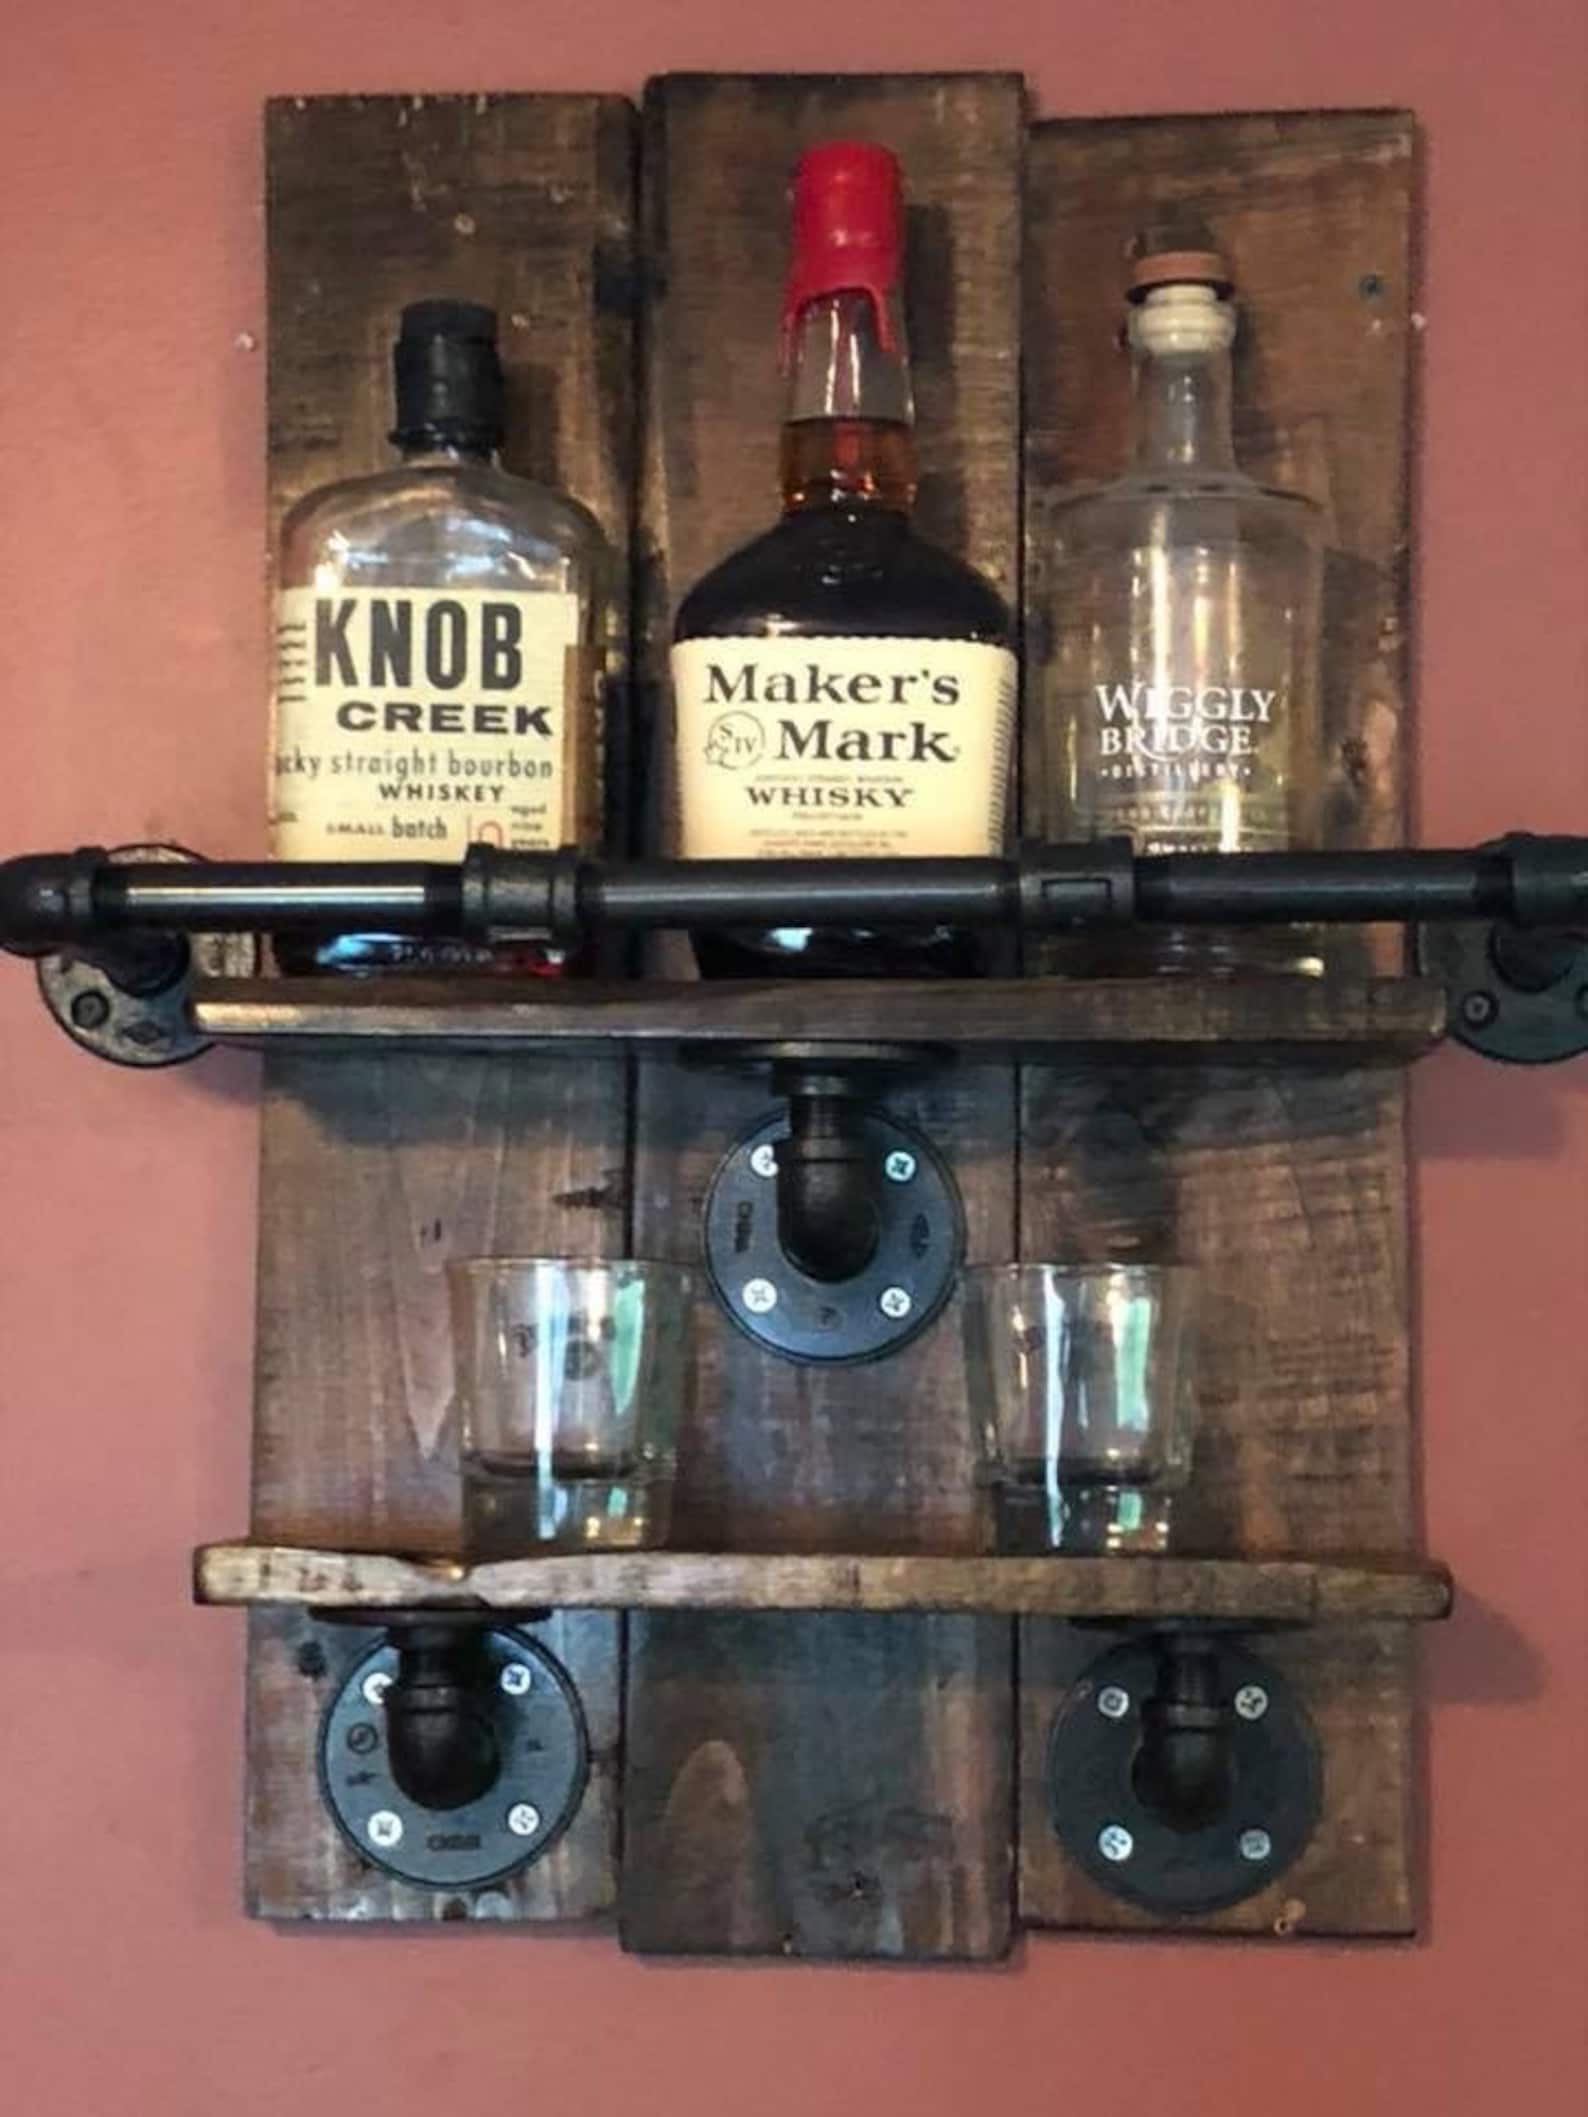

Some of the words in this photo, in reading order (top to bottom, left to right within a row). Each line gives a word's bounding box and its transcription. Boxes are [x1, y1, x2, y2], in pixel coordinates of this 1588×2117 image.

[314, 599, 522, 690] KNOB
[704, 663, 960, 706] Maker's
[1096, 682, 1276, 722] WIGGLY
[337, 701, 553, 736] CREEK
[774, 720, 956, 763] Mark
[1100, 725, 1255, 762] BRIDGE
[331, 748, 438, 781] straight
[448, 752, 553, 778] bourbon
[378, 784, 504, 802] WHISKEY
[745, 787, 914, 807] WHISKY
[392, 816, 448, 839] batch
